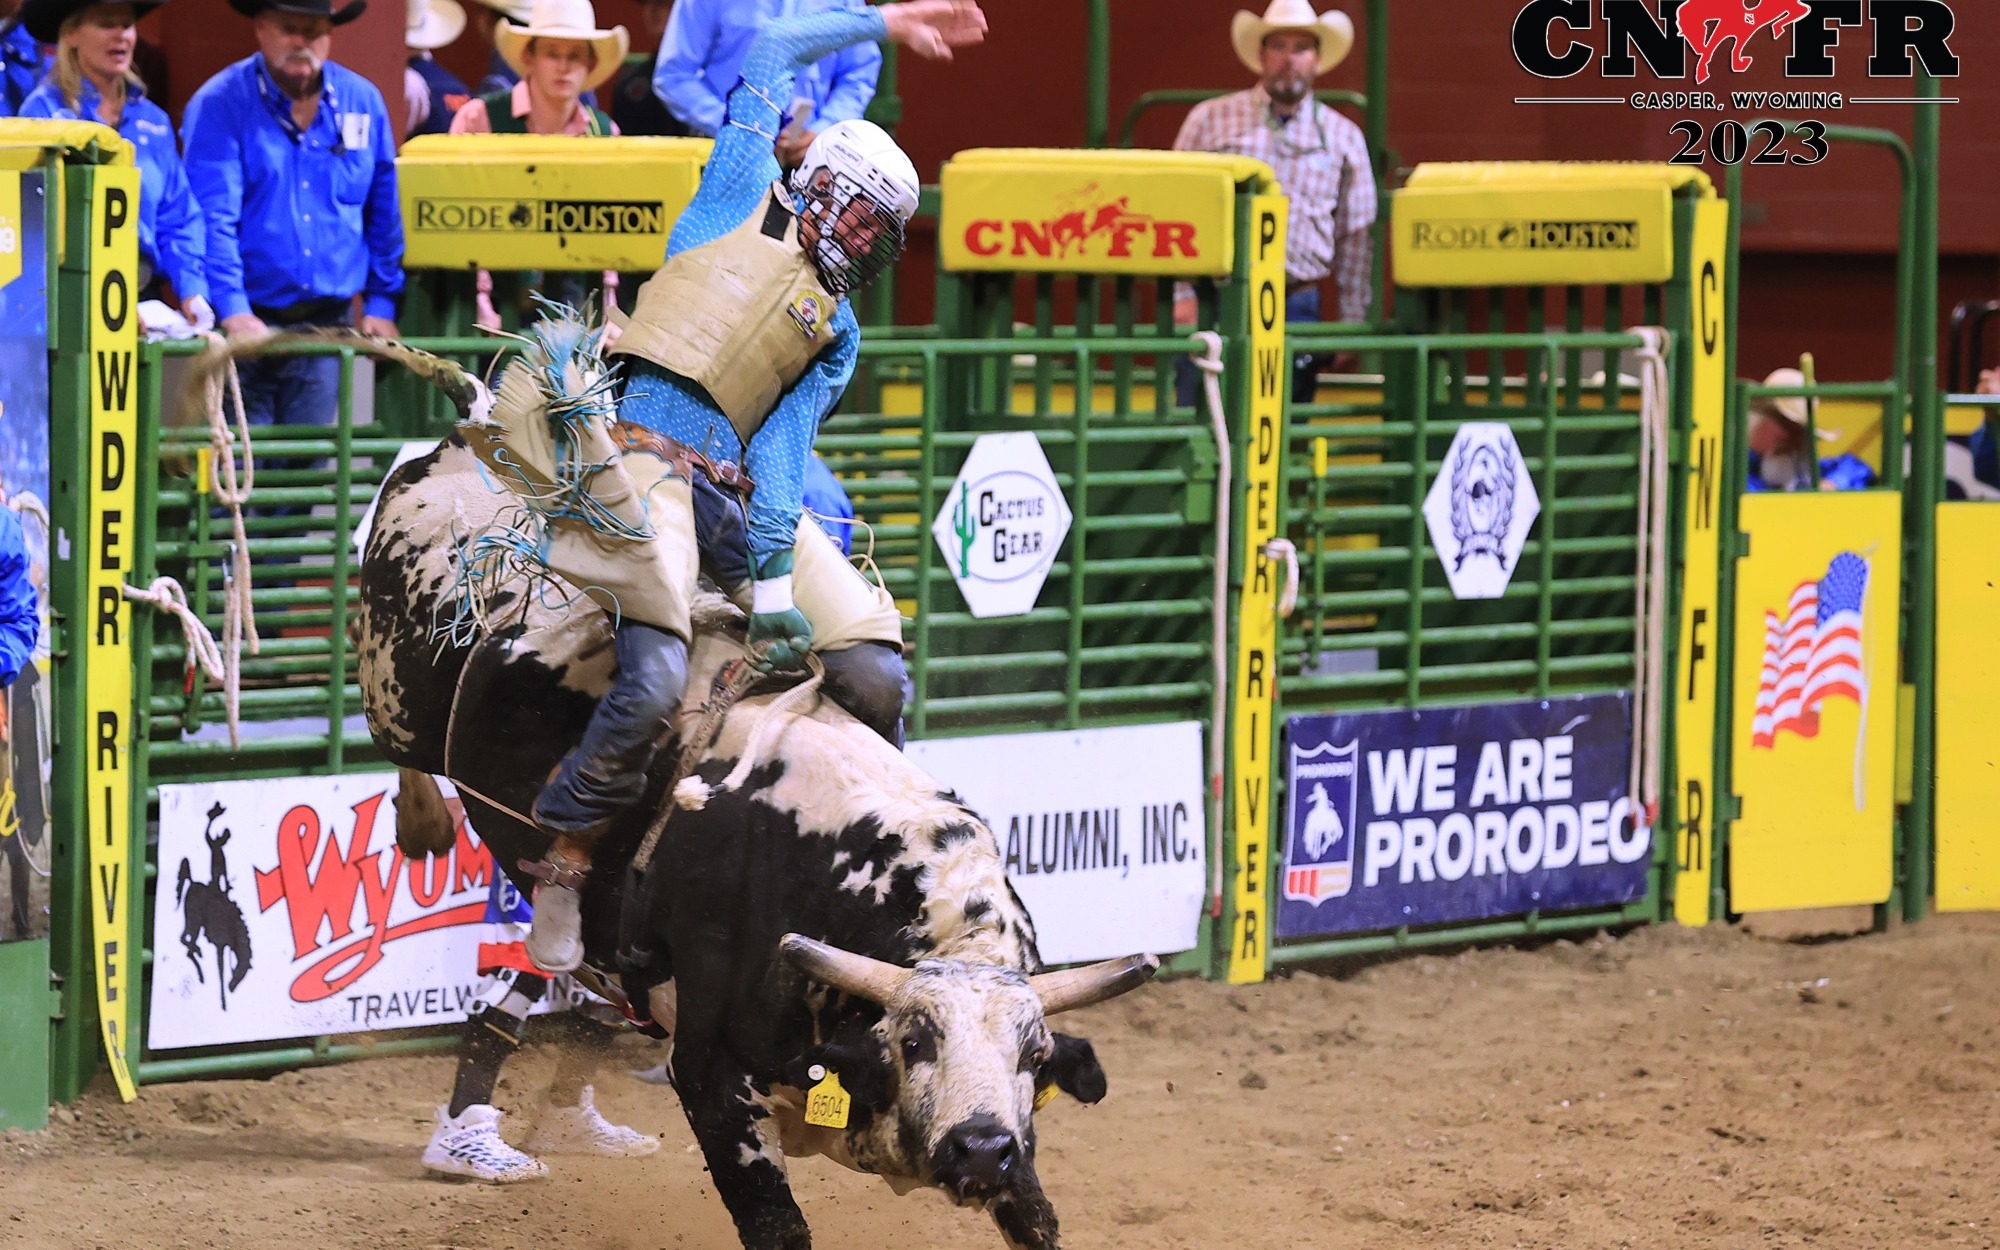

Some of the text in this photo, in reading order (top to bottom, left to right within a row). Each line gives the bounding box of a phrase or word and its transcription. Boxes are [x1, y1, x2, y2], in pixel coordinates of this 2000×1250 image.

[540, 200, 663, 232] HOUSTON
[1526, 220, 1640, 250] HOUSTON
[980, 490, 1045, 527] CACTUS
[994, 528, 1043, 563] GEAR
[1242, 212, 1279, 960] POWDER RIVER
[1682, 260, 1716, 872] CNFR
[97, 187, 132, 1080] POWDER RIVER
[1367, 735, 1574, 816] WE ARE
[1005, 802, 1198, 879] ALUMNI, INC.
[1363, 796, 1651, 888] PRORODEO
[812, 1093, 844, 1119] 6504
